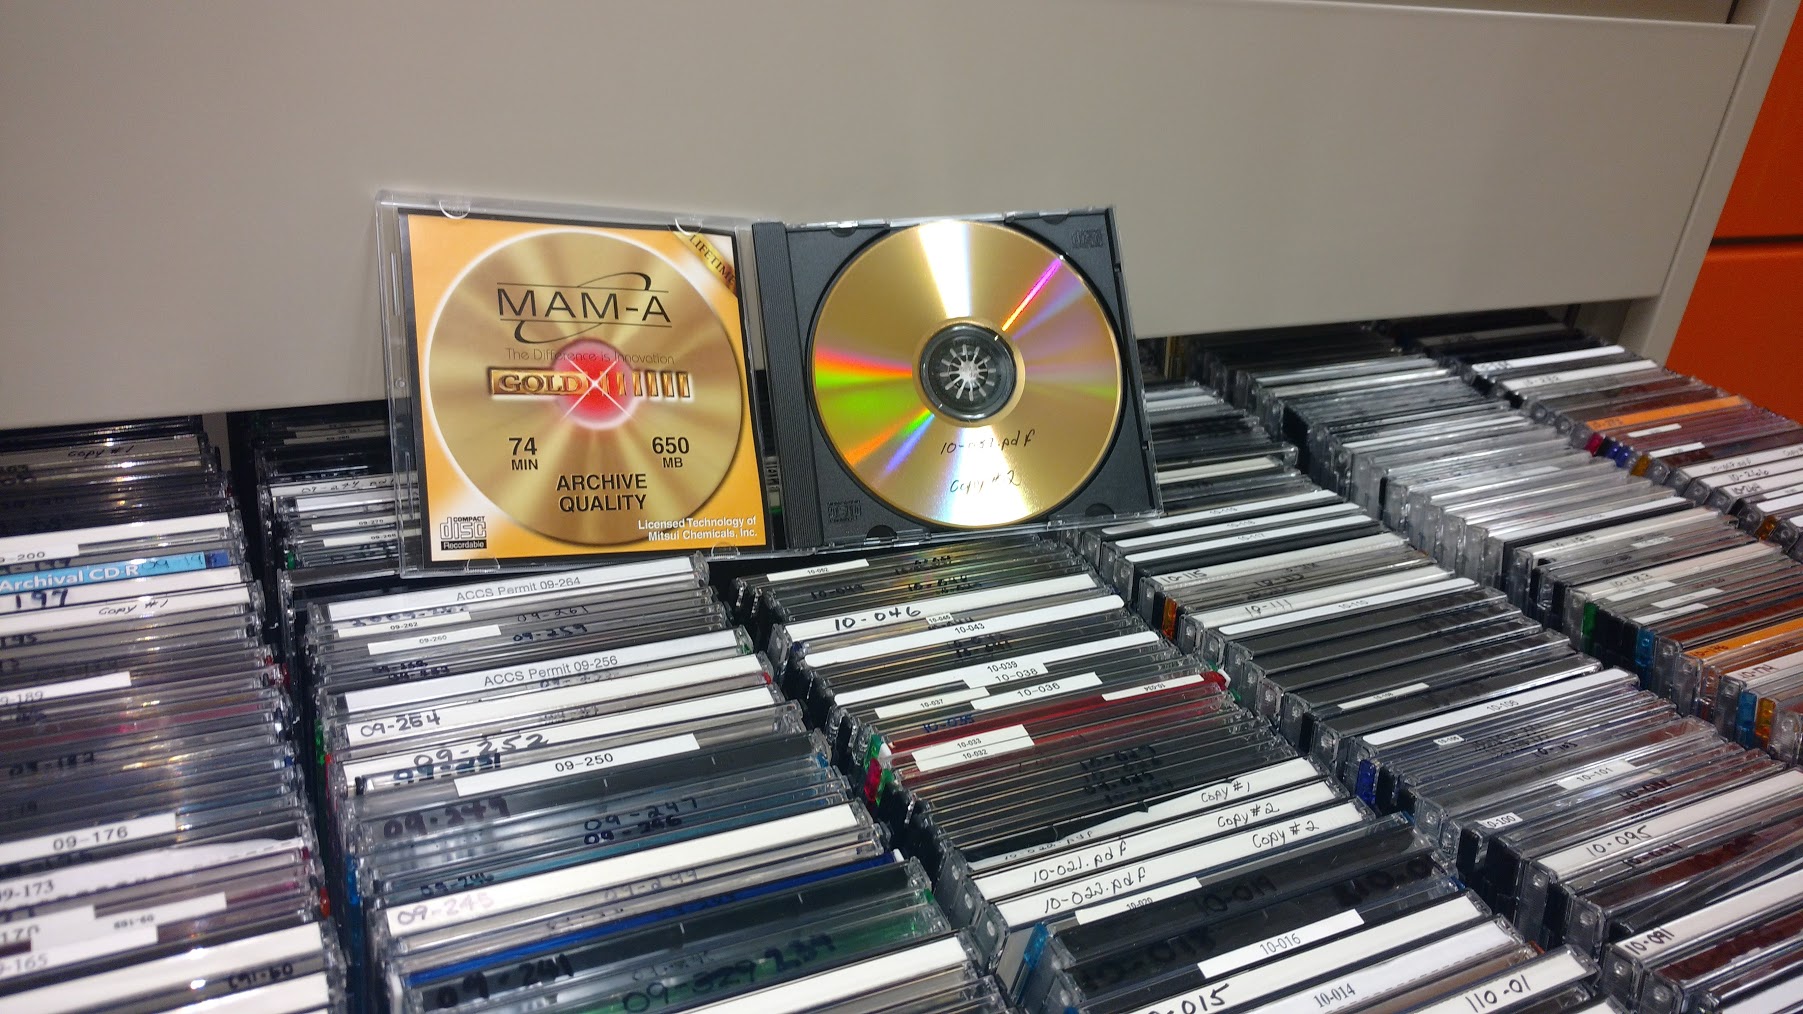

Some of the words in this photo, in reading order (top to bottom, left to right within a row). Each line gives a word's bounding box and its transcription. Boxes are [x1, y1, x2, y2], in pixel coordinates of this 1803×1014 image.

[497, 288, 671, 322] MAM-A
[505, 348, 530, 360] The
[533, 349, 598, 361] Difference
[601, 352, 611, 362] is
[614, 352, 676, 364] Innovation
[498, 374, 584, 393] GOLD
[509, 437, 538, 456] 74
[652, 436, 690, 454] 650
[511, 459, 539, 470] MIN
[662, 457, 683, 468] MB
[556, 473, 648, 491] ARCHIVE
[559, 494, 647, 513] QUALITY
[440, 517, 487, 539] disc
[638, 518, 686, 530] Licensed
[687, 517, 745, 530] Technology
[747, 515, 757, 525] of
[648, 530, 680, 542] Mitsui
[683, 529, 738, 541] Chemicals,
[740, 527, 758, 537] Inc.
[443, 541, 485, 549] Recordable
[0, 570, 84, 592] Archival
[89, 564, 139, 581] CD-R
[456, 587, 494, 602] ACCS
[498, 582, 538, 596] Permit
[540, 576, 582, 590] 09-264
[98, 604, 138, 616] Copy
[517, 604, 589, 622] 09-261
[834, 605, 922, 632] 10-046
[390, 621, 419, 631] 09-262
[954, 622, 986, 635] 10-043
[418, 634, 448, 644] 09-260
[484, 672, 525, 687] ACCS
[528, 664, 571, 680] Permit
[573, 654, 619, 672] 09-256
[986, 660, 1019, 674] 10-039
[995, 667, 1039, 683] 10-038
[1016, 681, 1061, 699] 10-036
[360, 709, 441, 738] 09-254
[413, 733, 550, 768] 09-252
[956, 737, 983, 749] 10-033
[554, 752, 614, 773] 09-250
[962, 748, 988, 761] 10-032
[1576, 766, 1614, 783] 10-101
[1200, 785, 1232, 803] Copy
[584, 797, 698, 832] 09-247
[1217, 810, 1249, 830] Copy
[1484, 813, 1516, 829] 0-100
[52, 825, 129, 851] 09-176
[1252, 825, 1287, 848] Copy
[1259, 932, 1302, 956] 10-016
[1148, 982, 1230, 1014] -015
[1312, 982, 1356, 1009] 10-014
